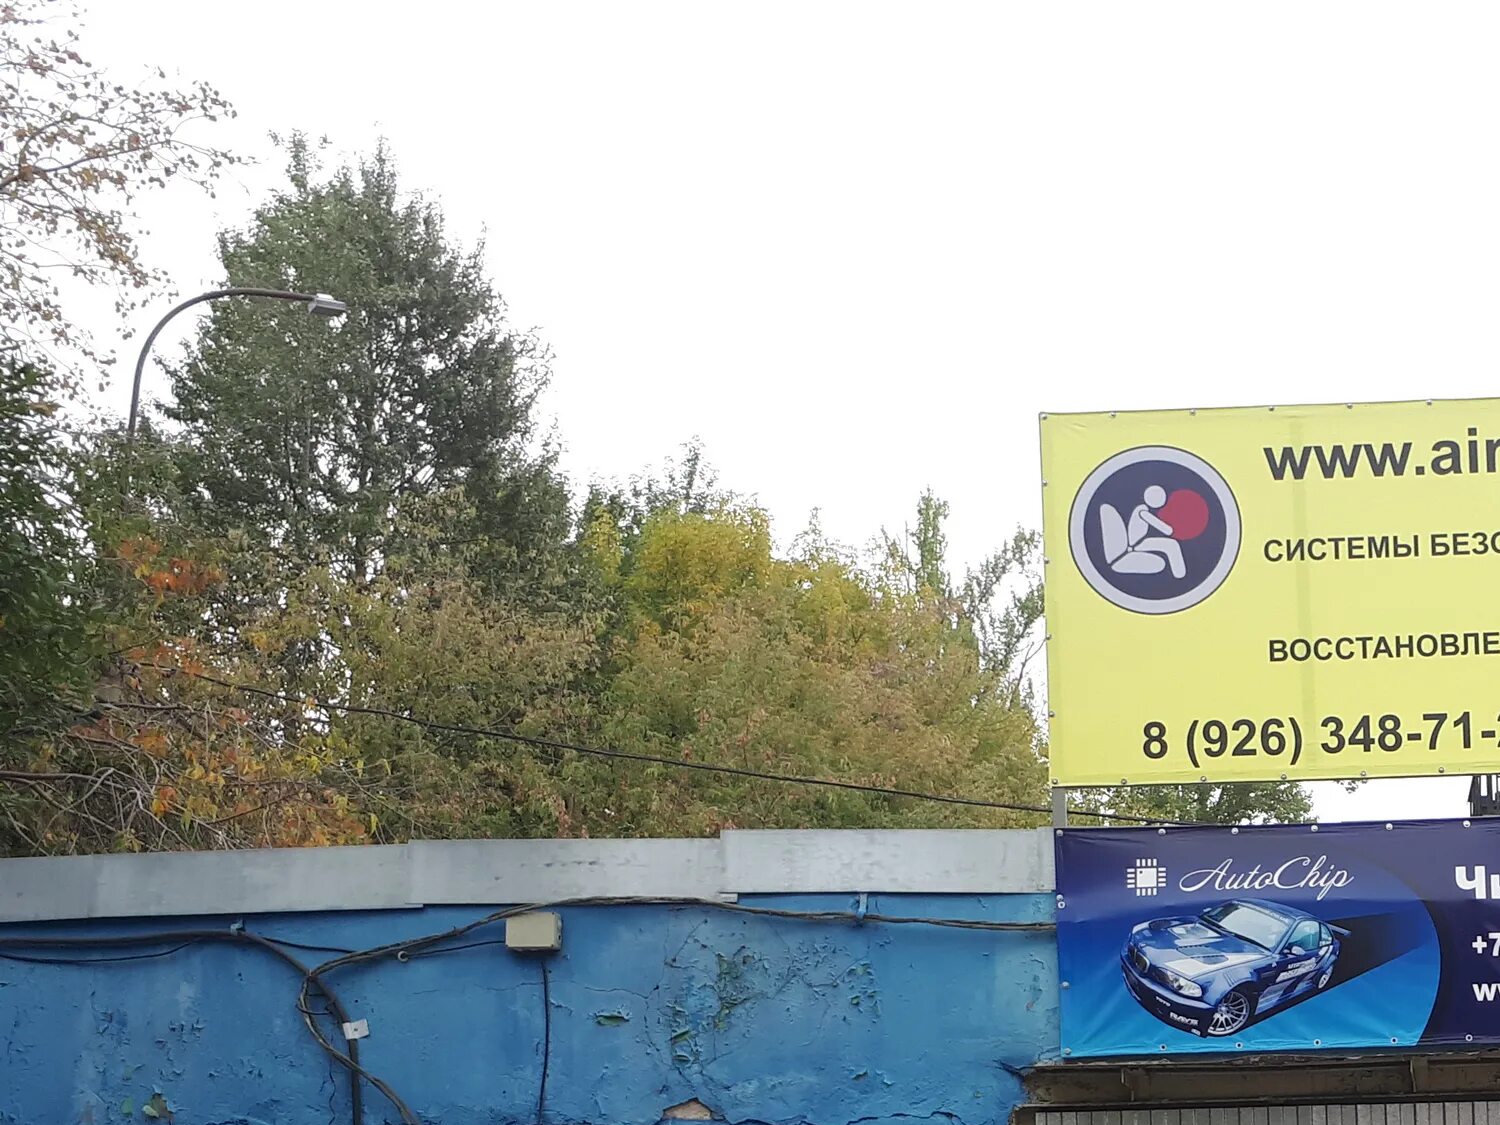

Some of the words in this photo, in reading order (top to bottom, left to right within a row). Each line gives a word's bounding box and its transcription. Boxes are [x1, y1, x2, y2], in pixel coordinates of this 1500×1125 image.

[1264, 535, 1419, 562] СИСТЕМЫ
[1143, 722, 1167, 759] 8
[1187, 717, 1302, 768] (926)
[1179, 856, 1354, 900] AutoChip
